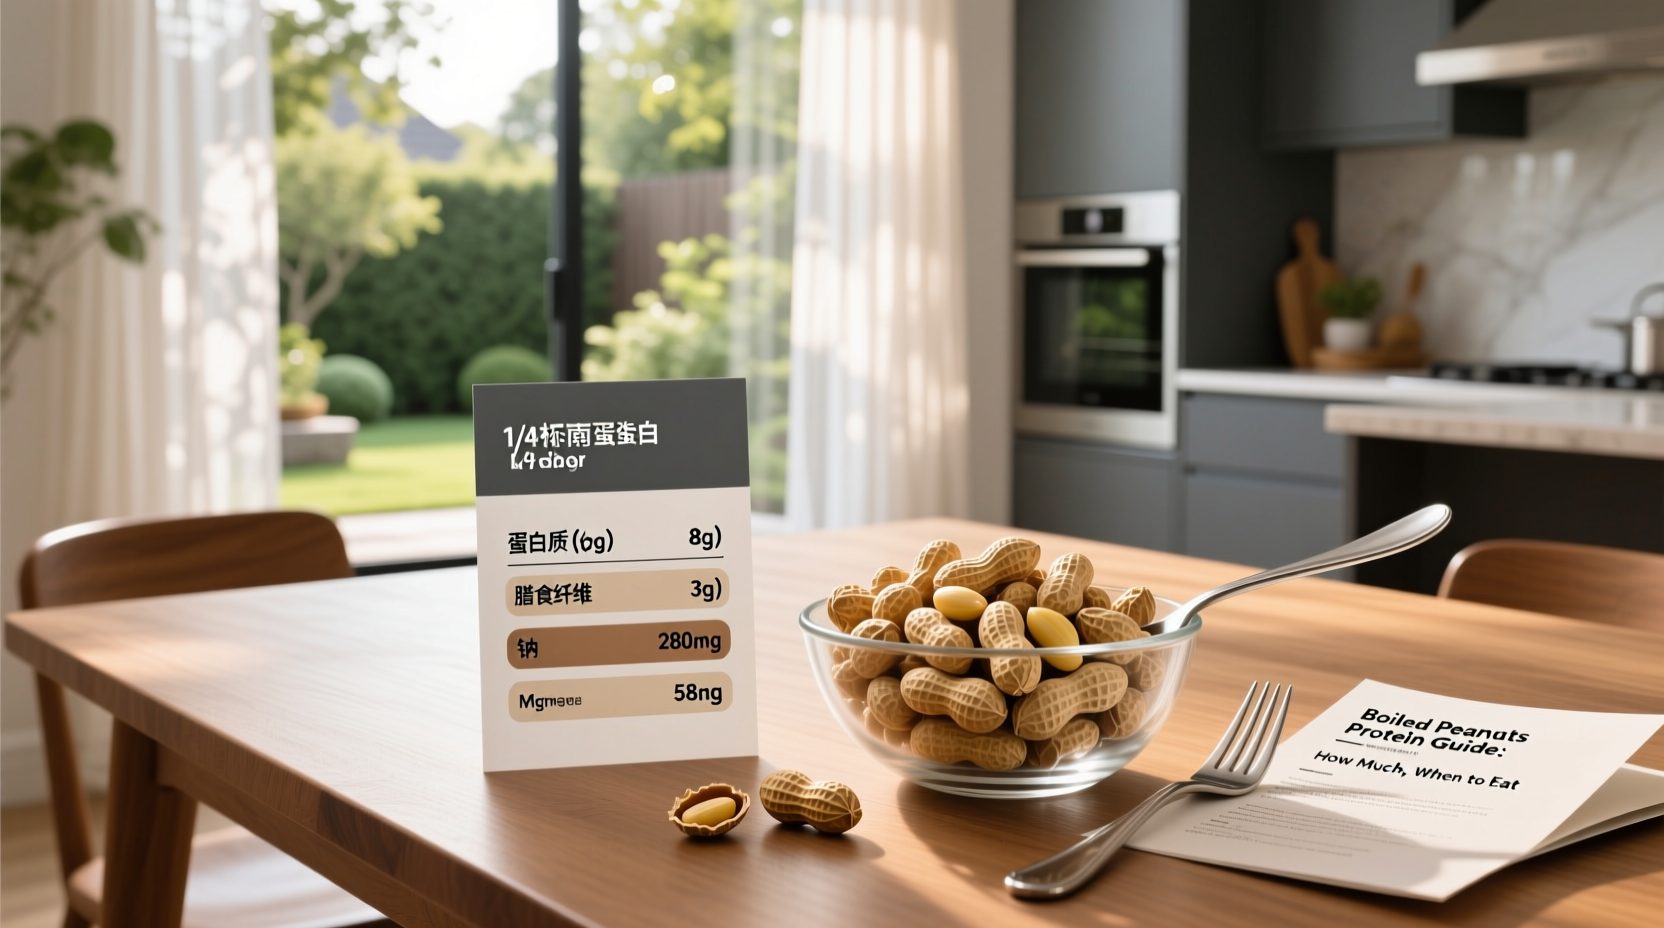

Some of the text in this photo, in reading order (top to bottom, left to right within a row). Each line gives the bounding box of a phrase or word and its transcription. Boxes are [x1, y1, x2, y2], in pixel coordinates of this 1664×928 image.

[689, 525, 722, 550] 8g)
[690, 576, 722, 602] 3g)
[517, 631, 722, 659] 钠 280mg
[674, 683, 723, 706] 58ng
[1360, 708, 1433, 731] Boiled
[1344, 722, 1425, 747] Protein
[1430, 737, 1507, 757] Guide:
[1314, 750, 1520, 791] How Much, When to Eat
